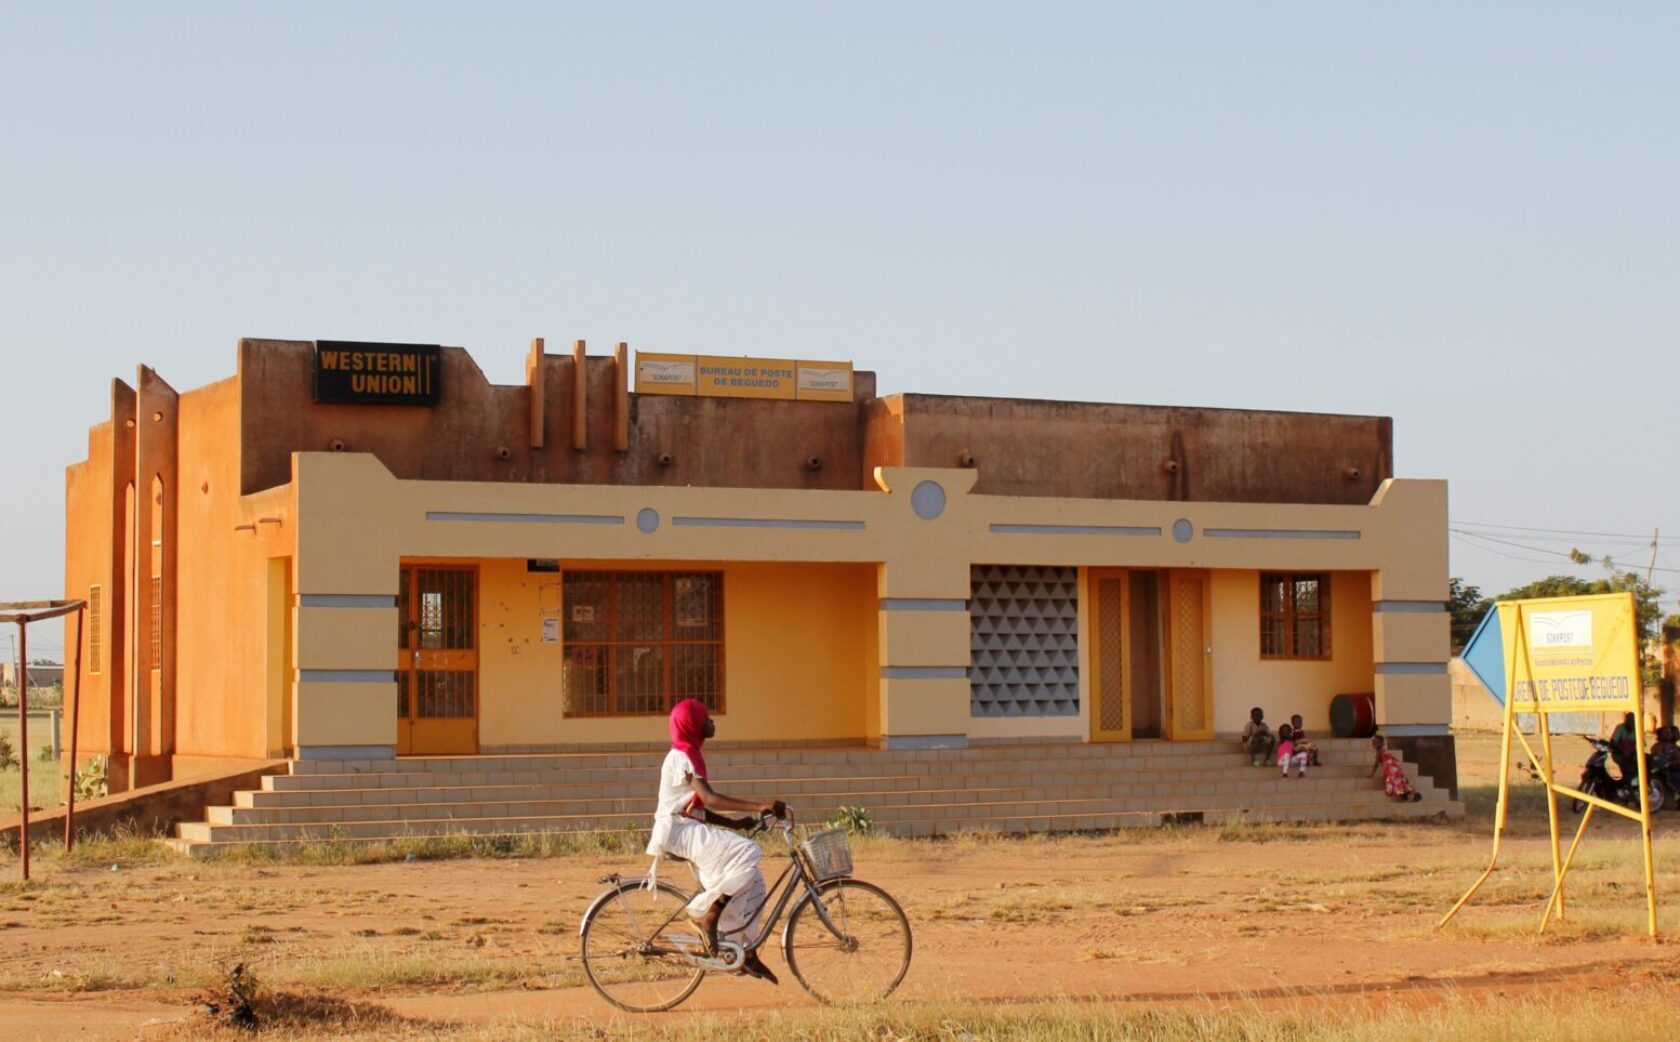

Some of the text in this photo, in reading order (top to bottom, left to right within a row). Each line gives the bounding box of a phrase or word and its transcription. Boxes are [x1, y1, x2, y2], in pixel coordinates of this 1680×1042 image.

[321, 351, 416, 372] WESTERN
[700, 367, 793, 378] BUREAU DE POSTE
[352, 374, 416, 394] UNION
[714, 377, 779, 388] DE BEGUEDO
